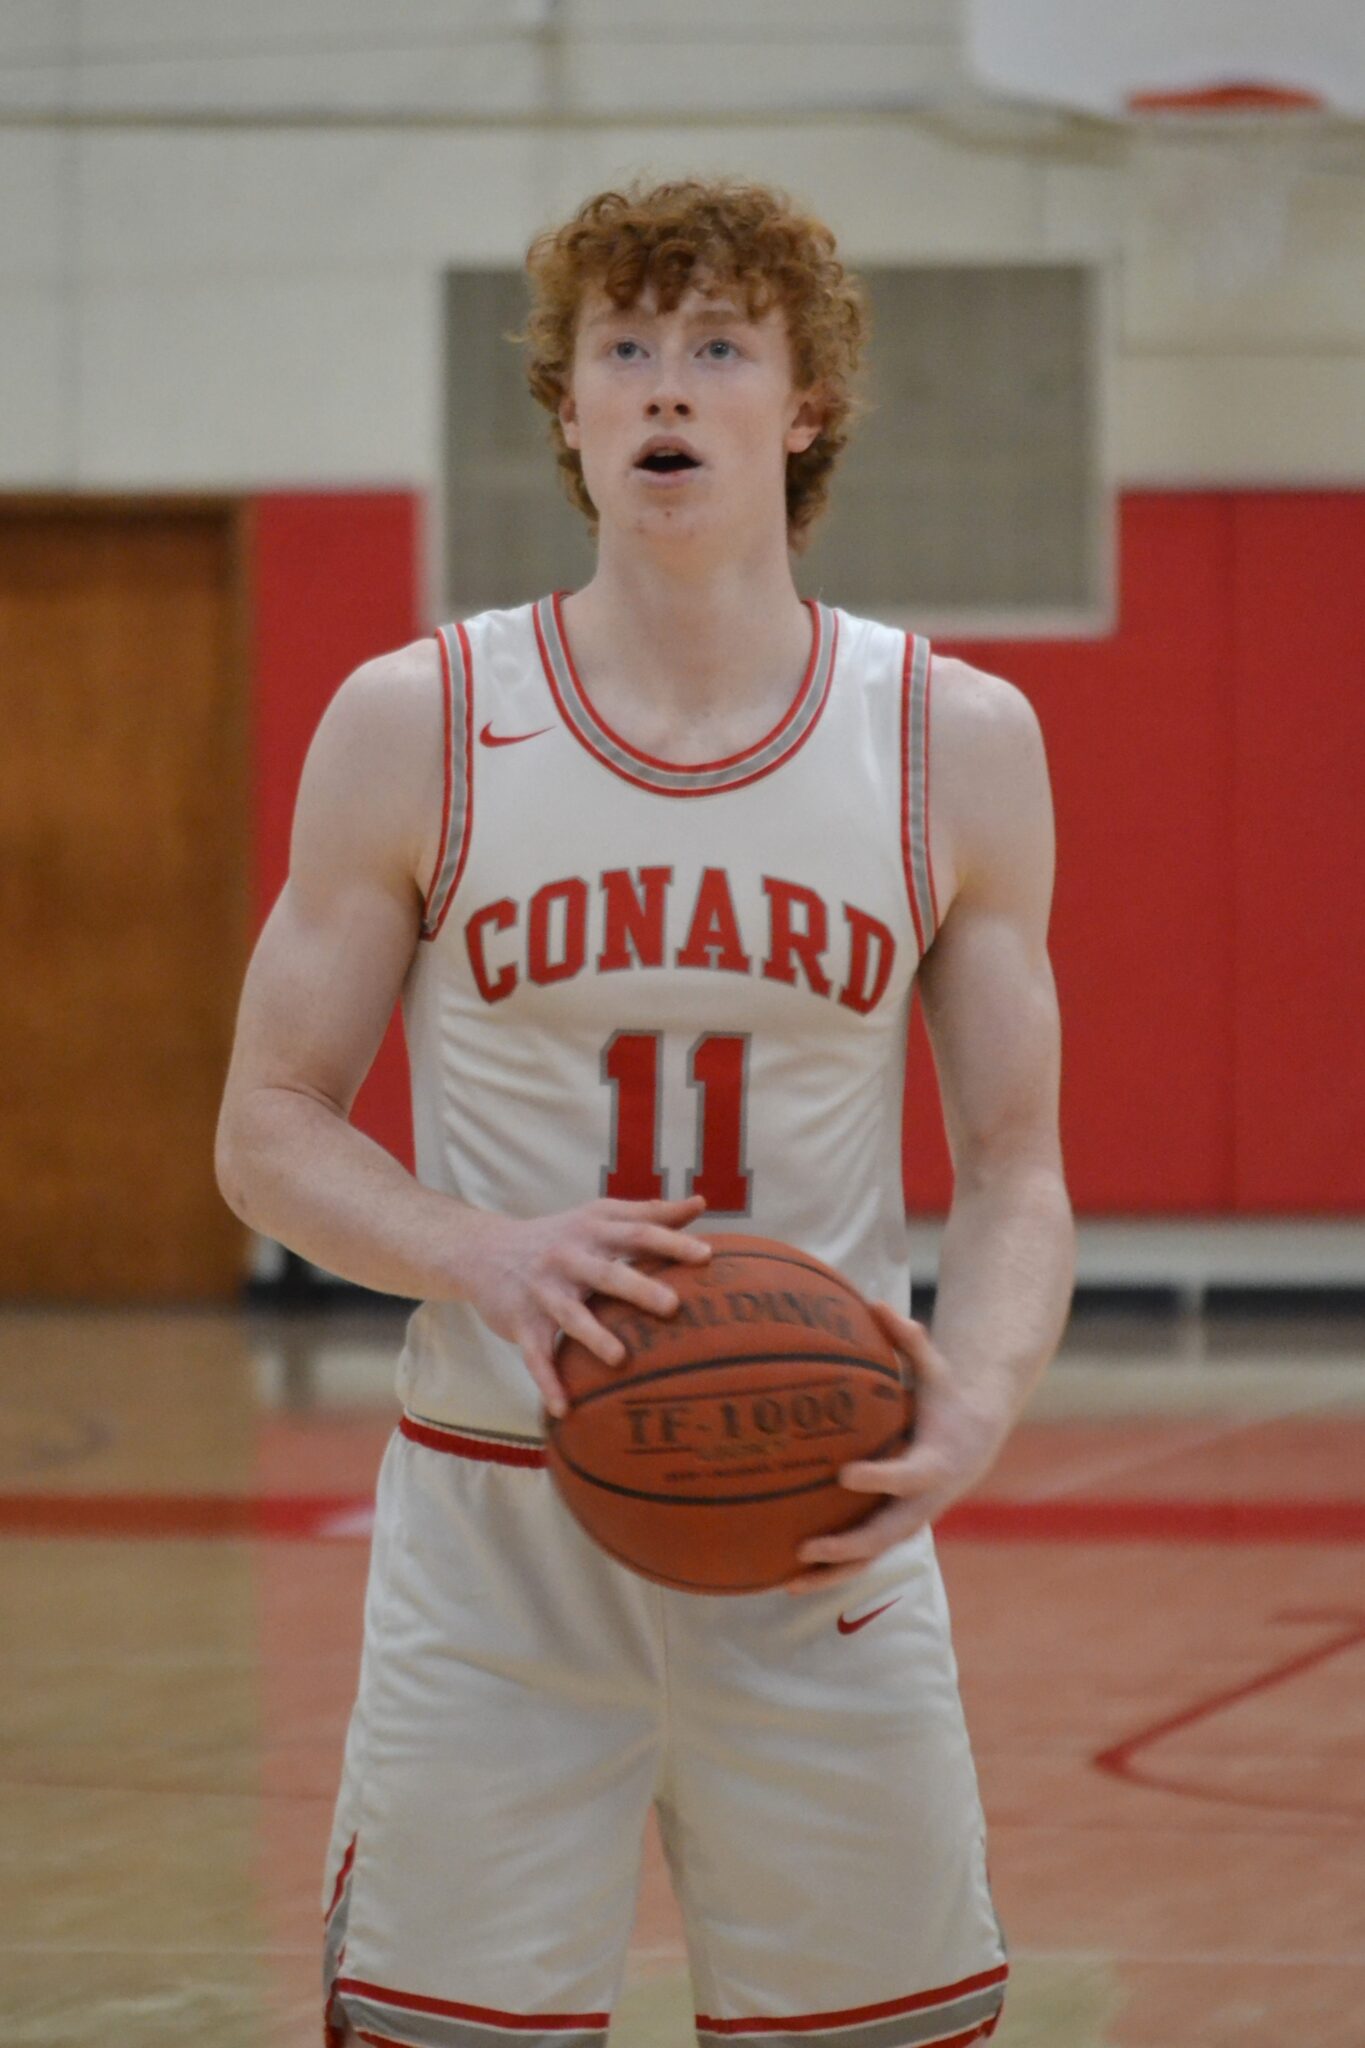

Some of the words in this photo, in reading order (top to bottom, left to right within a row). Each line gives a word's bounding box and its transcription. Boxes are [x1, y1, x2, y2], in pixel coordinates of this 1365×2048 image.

[464, 865, 897, 1017] CONARD
[600, 1028, 754, 1219] 11
[627, 1389, 855, 1445] TF-1000
